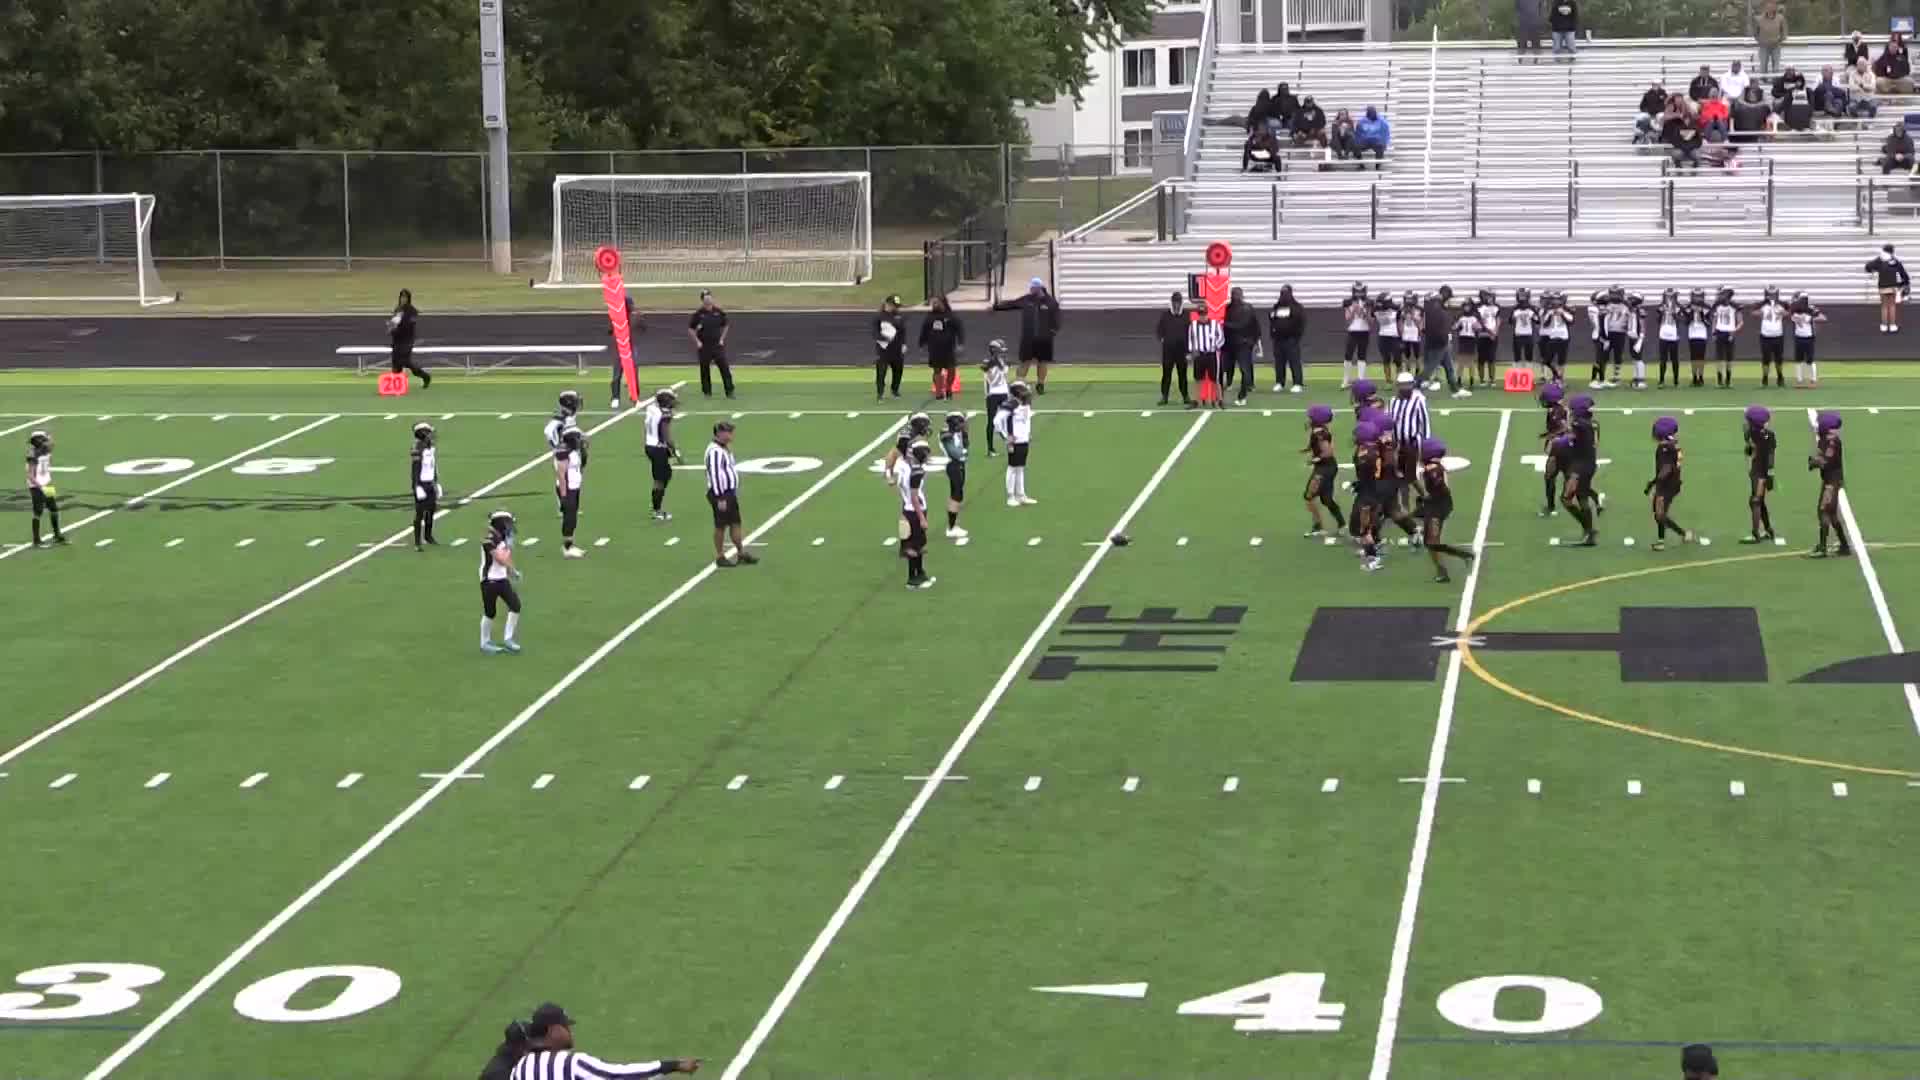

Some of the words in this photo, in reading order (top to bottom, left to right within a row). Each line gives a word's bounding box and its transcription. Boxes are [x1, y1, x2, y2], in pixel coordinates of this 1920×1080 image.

[384, 376, 402, 391] 20
[1510, 373, 1529, 387] 40
[0, 961, 403, 1022] 30
[1176, 971, 1604, 1033] 40
